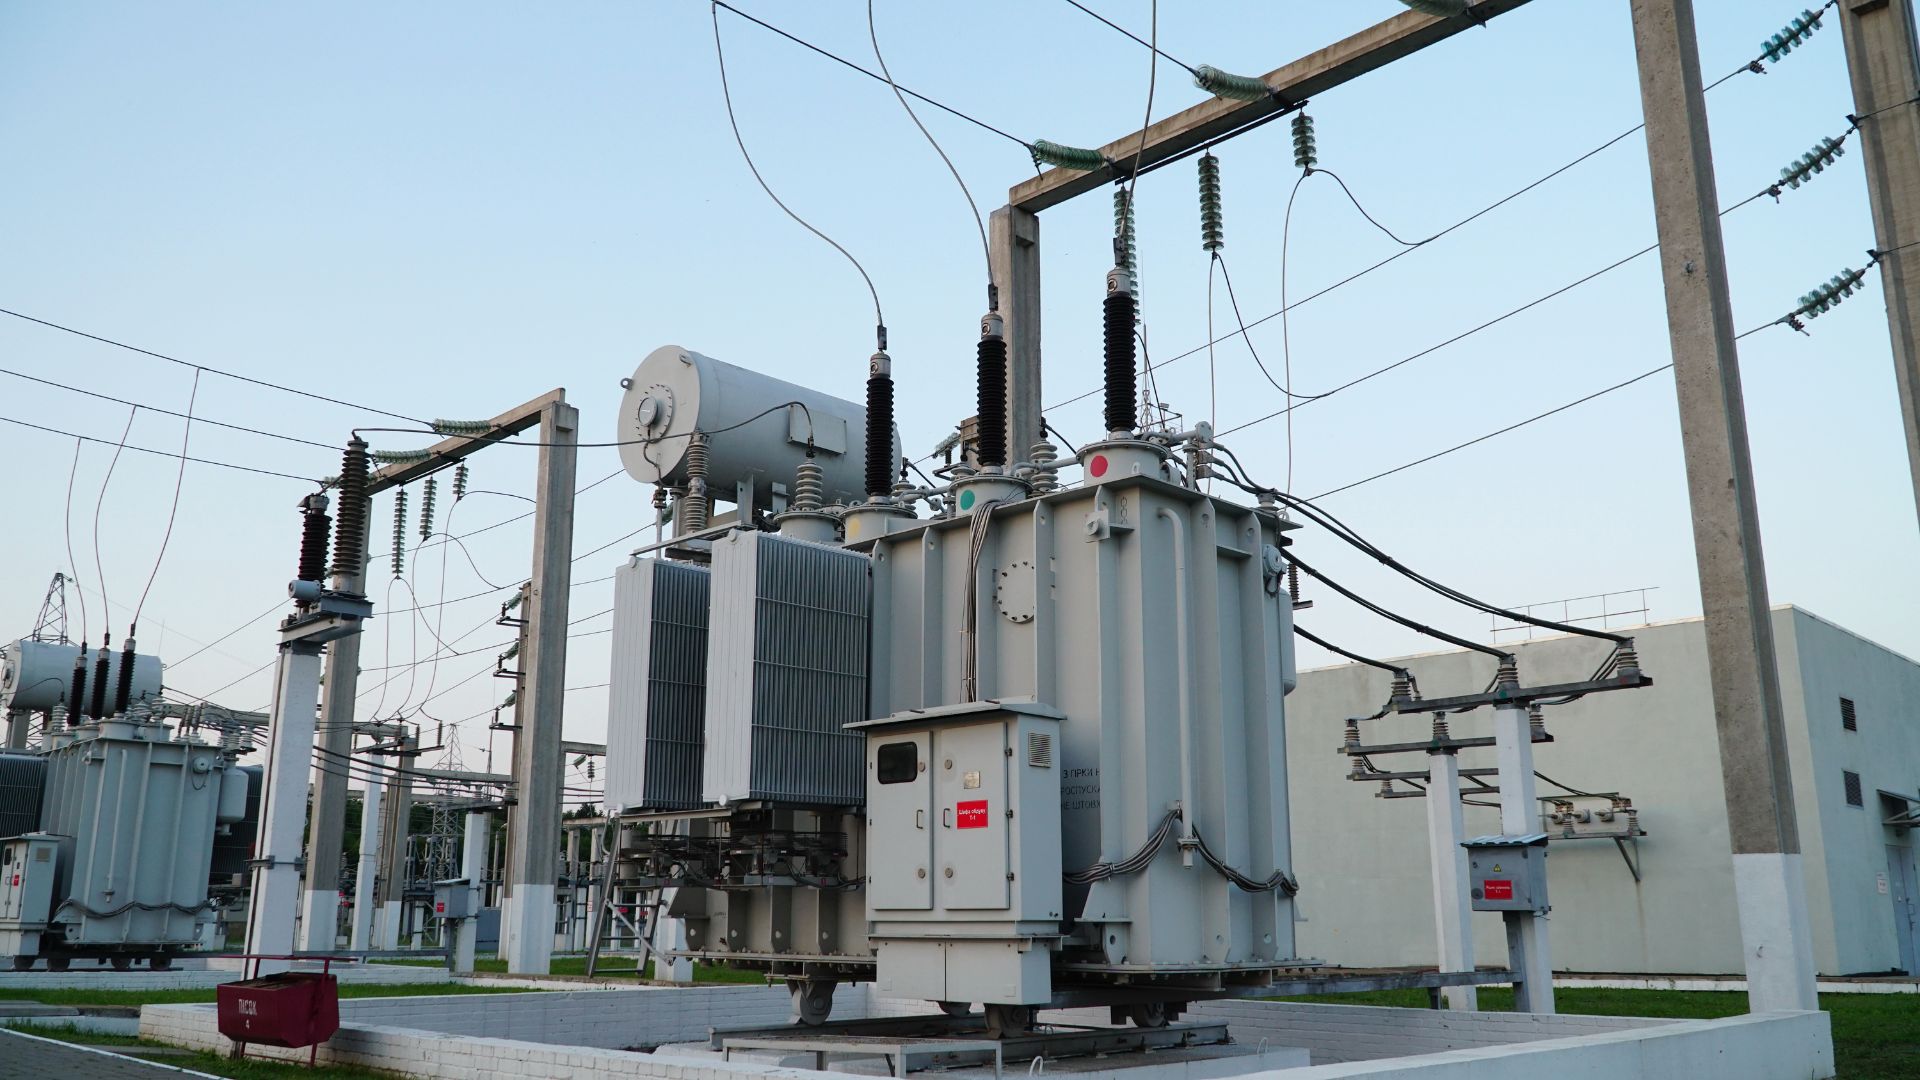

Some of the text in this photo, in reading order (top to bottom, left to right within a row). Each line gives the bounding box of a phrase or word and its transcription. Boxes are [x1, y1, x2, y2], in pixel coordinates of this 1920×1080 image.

[1063, 769, 1069, 779] З
[1070, 768, 1093, 778] ГІРКИ
[245, 1019, 250, 1029] 4
